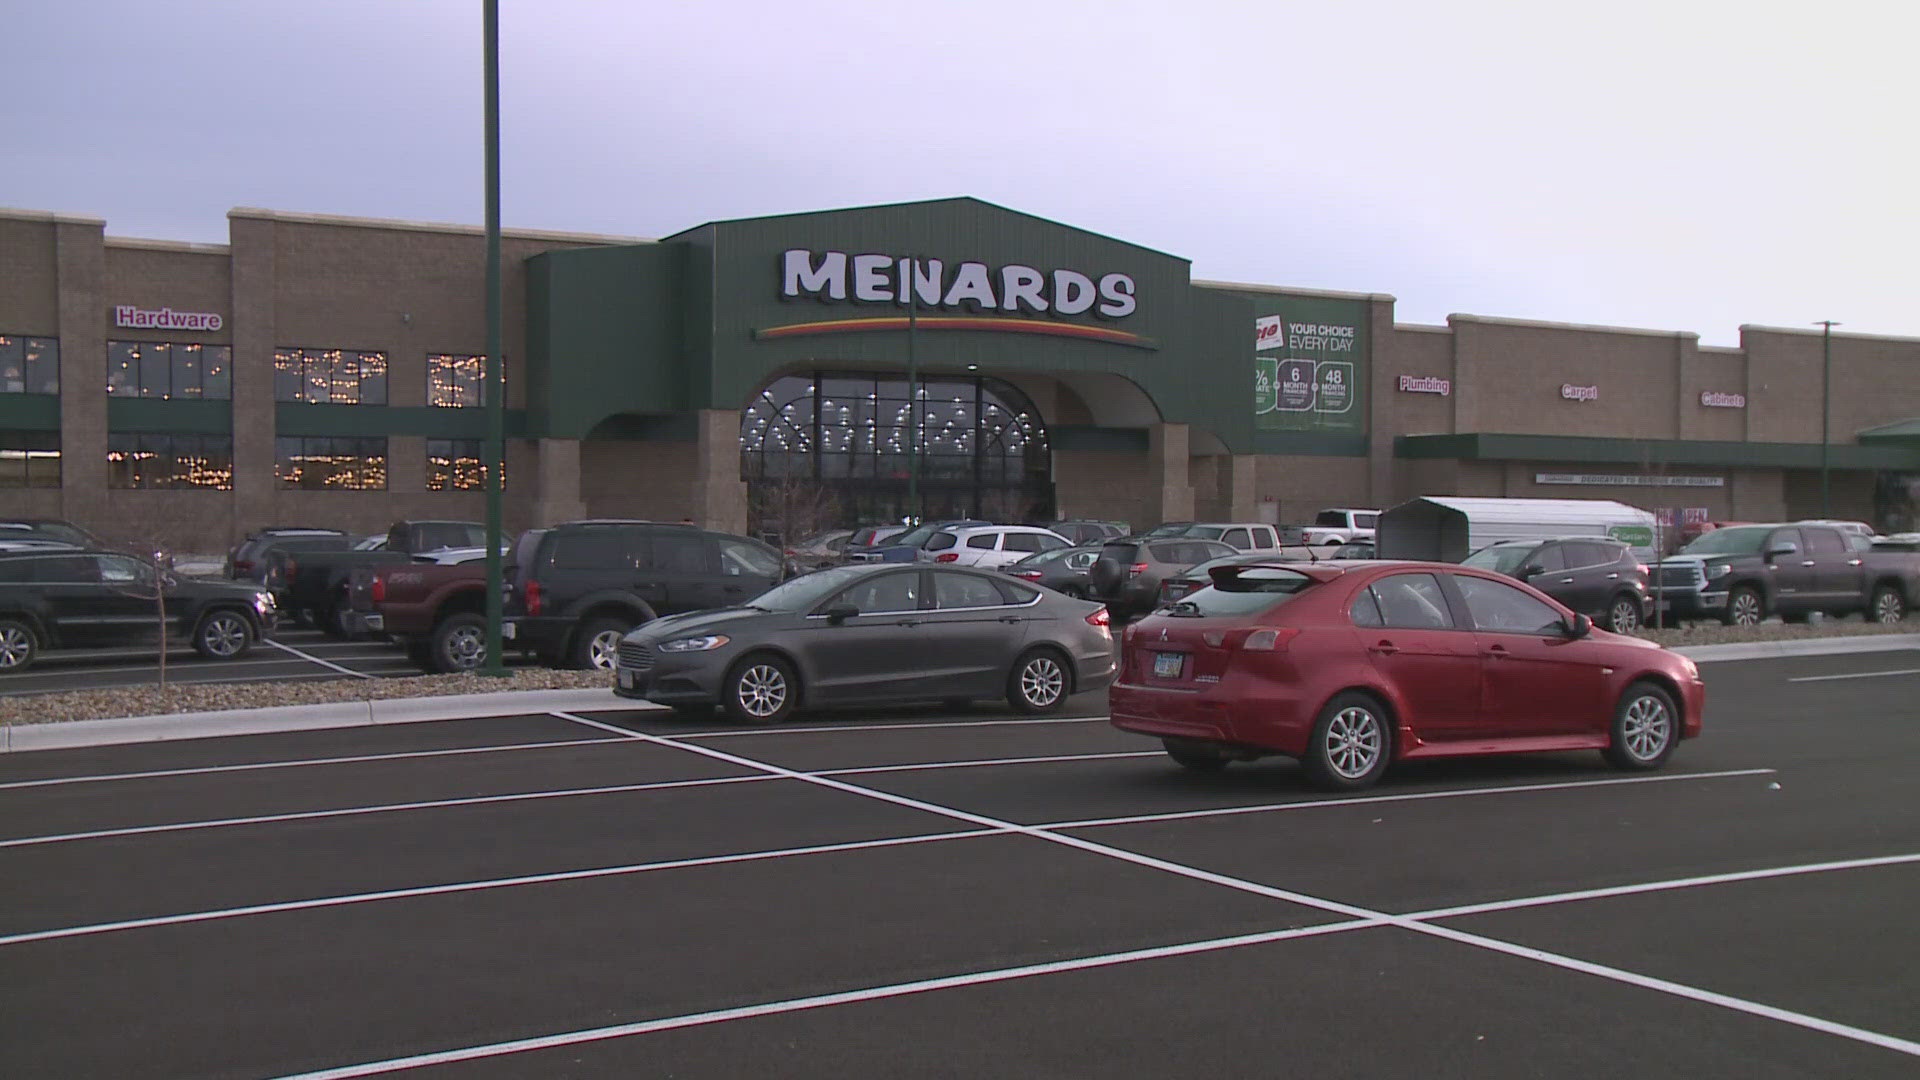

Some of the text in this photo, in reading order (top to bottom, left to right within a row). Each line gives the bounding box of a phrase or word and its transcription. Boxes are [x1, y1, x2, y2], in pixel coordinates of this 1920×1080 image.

[784, 249, 1137, 317] MENARDS
[116, 305, 223, 331] Hardware
[1289, 323, 1354, 338] YOUR CHOICE
[1289, 335, 1354, 352] EVERY DAY
[1291, 367, 1300, 382] 6
[1325, 369, 1342, 384] 48
[1283, 381, 1308, 389] MONTH
[1321, 383, 1346, 391] MONTH
[1400, 375, 1450, 395] Plumbing
[1562, 383, 1597, 402] Carpet
[1702, 391, 1745, 408] Cabinets
